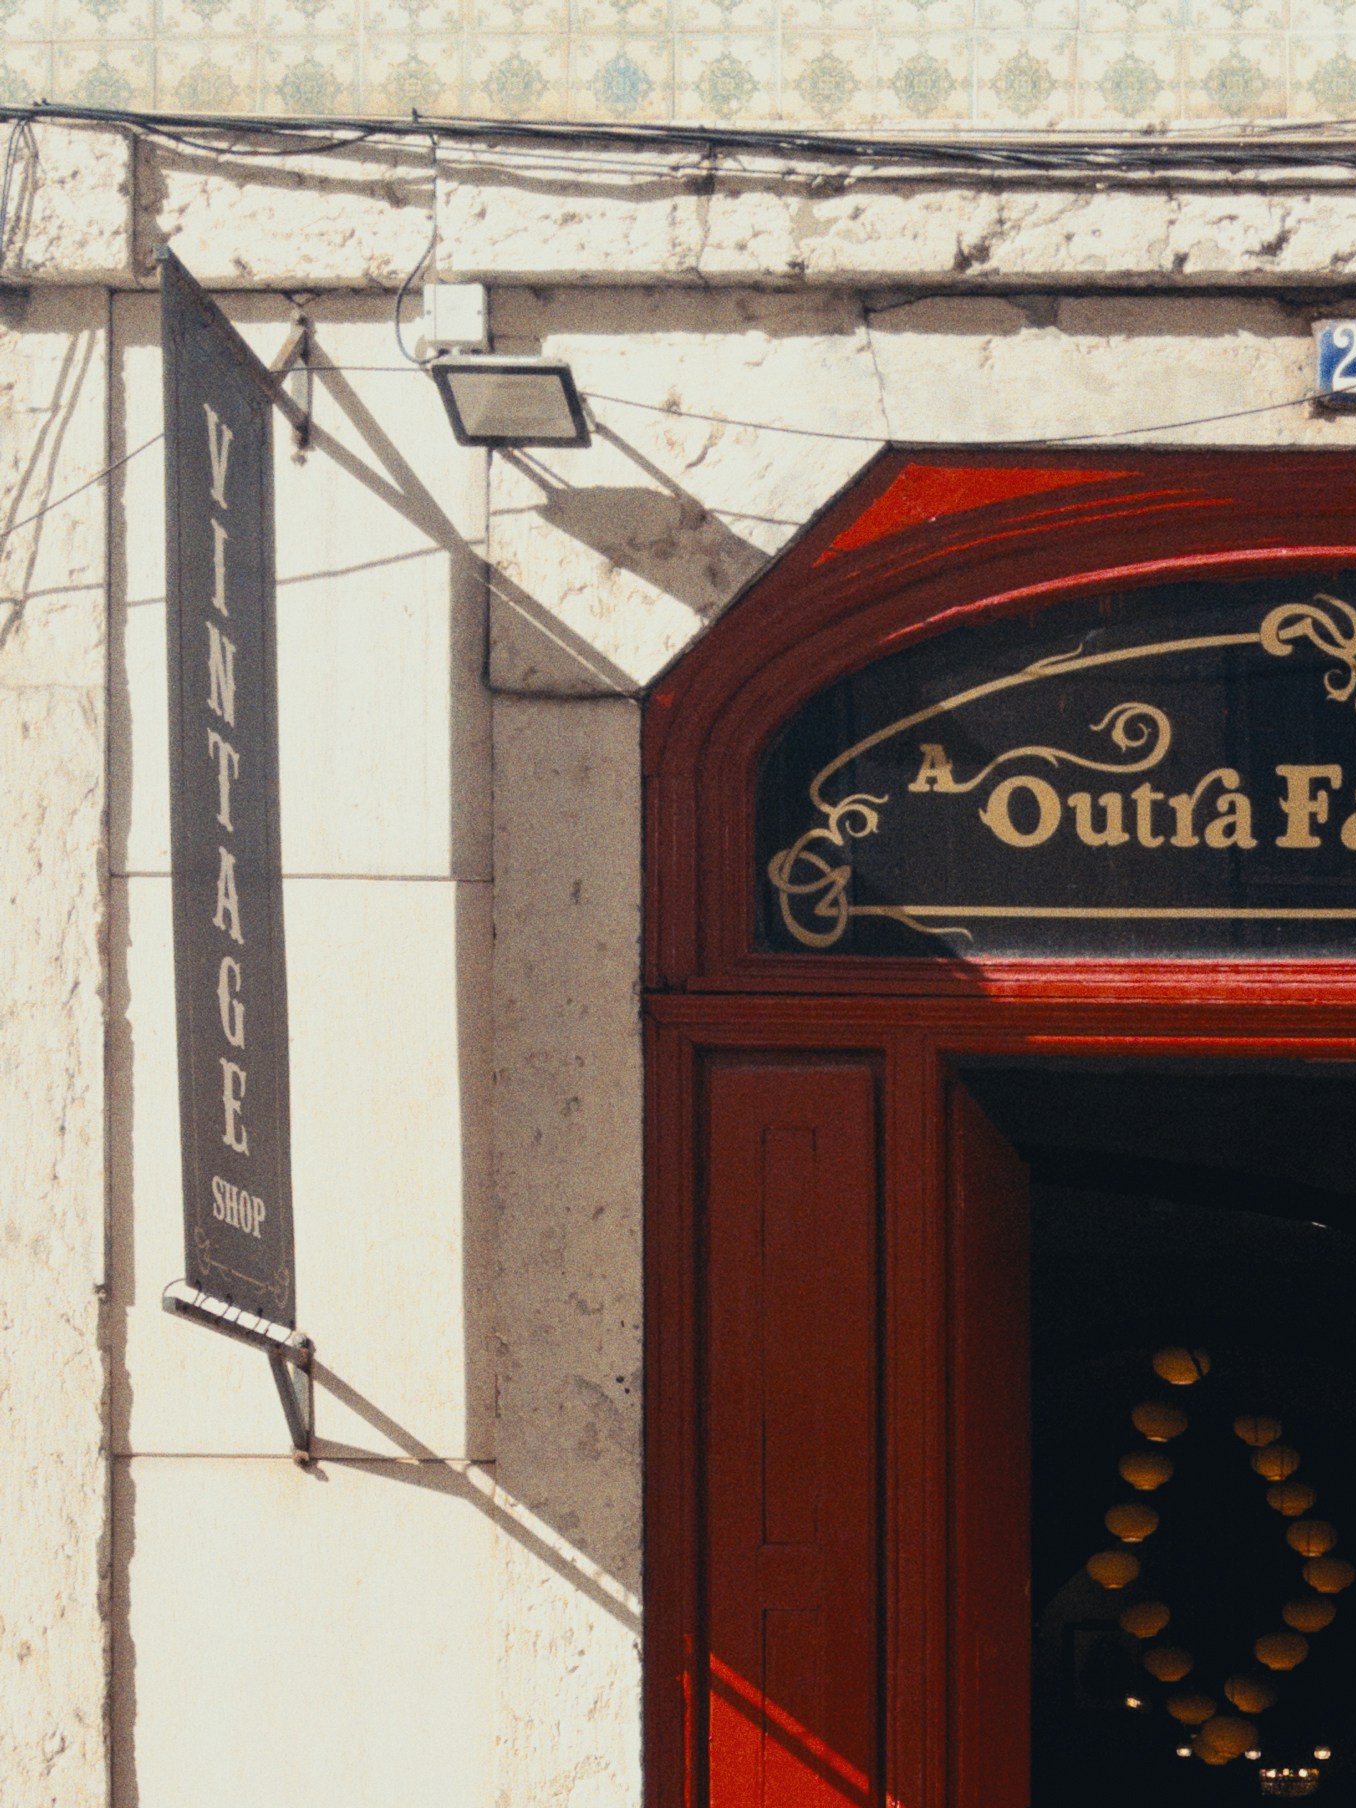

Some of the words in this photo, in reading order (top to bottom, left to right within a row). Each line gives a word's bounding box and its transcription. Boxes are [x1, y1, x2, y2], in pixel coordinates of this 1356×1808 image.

[203, 403, 251, 1157] VINTAGE
[907, 743, 955, 793] A
[978, 767, 1258, 850] Outra
[211, 1175, 266, 1239] SHOP
